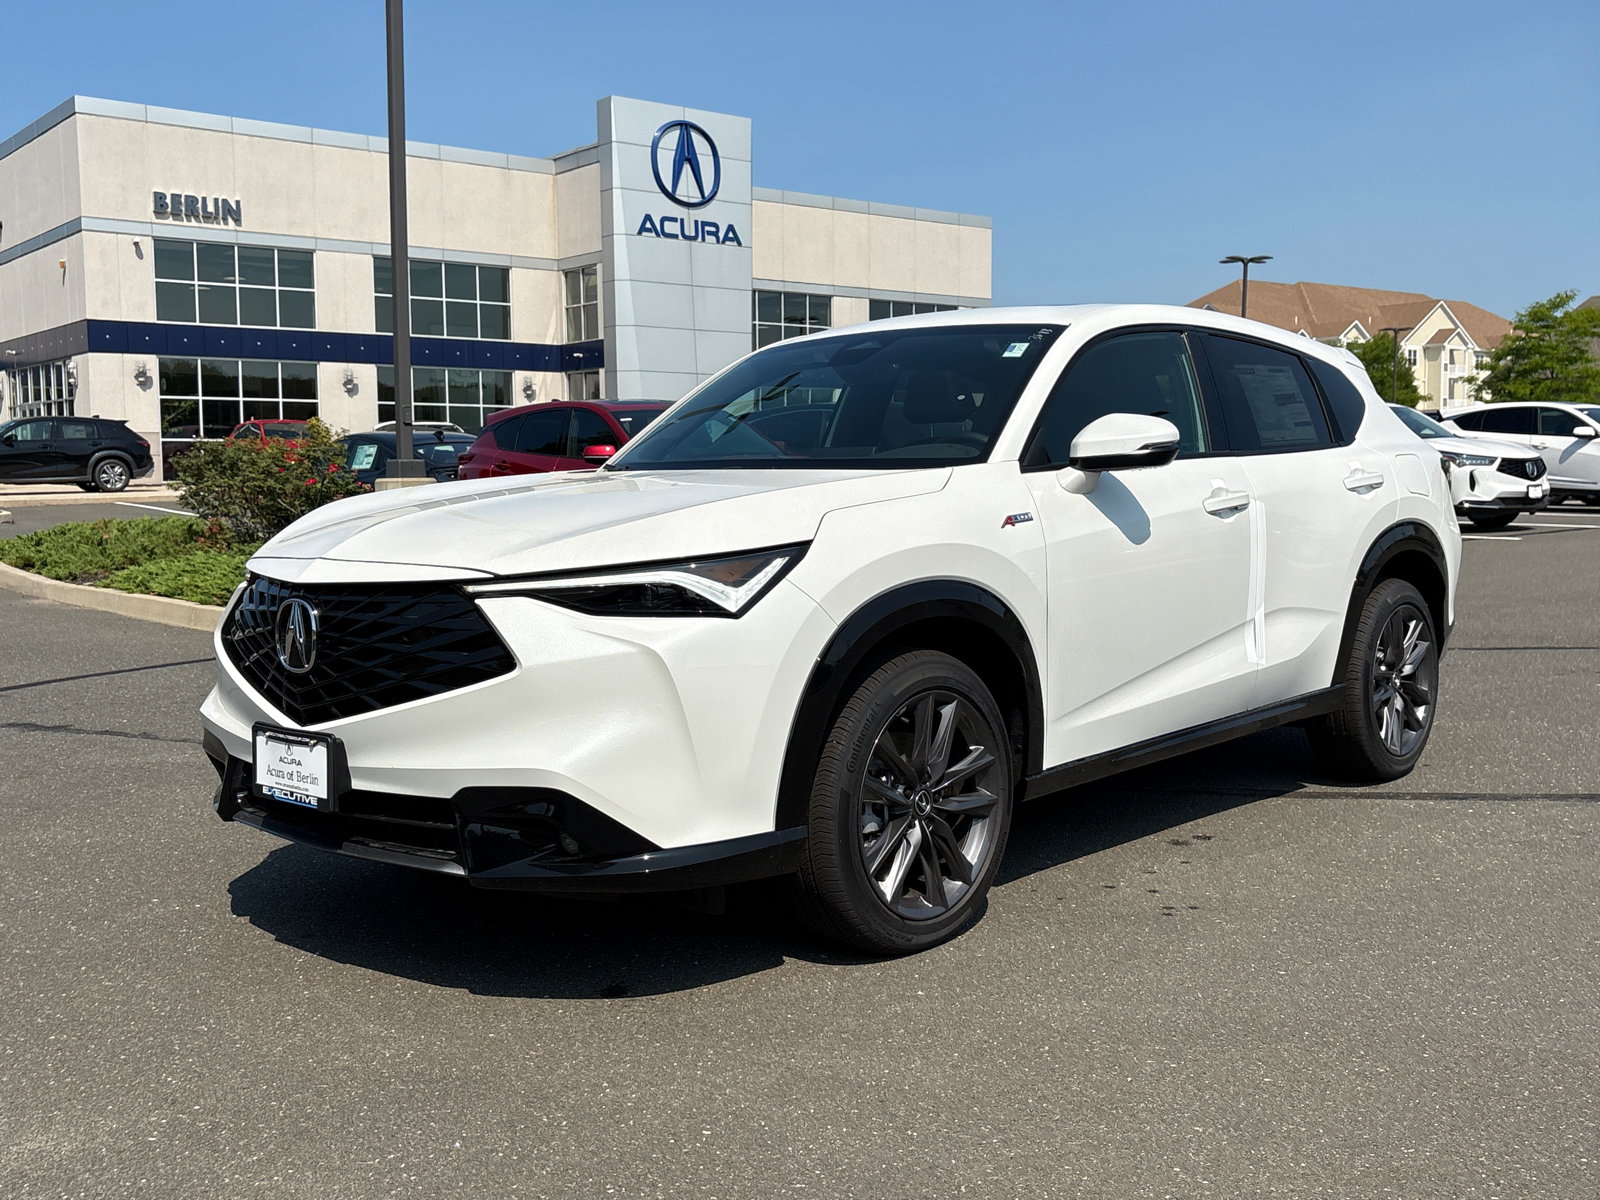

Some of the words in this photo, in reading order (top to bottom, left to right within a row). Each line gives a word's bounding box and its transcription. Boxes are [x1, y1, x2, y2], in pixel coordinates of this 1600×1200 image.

[153, 191, 242, 222] BERLIN
[636, 213, 743, 247] ACURA
[846, 708, 877, 773] Continental
[279, 757, 302, 767] ACURA
[266, 765, 285, 780] Acura
[286, 771, 294, 782] of
[296, 771, 319, 786] Berlin
[262, 785, 318, 806] EXECUTIVE
